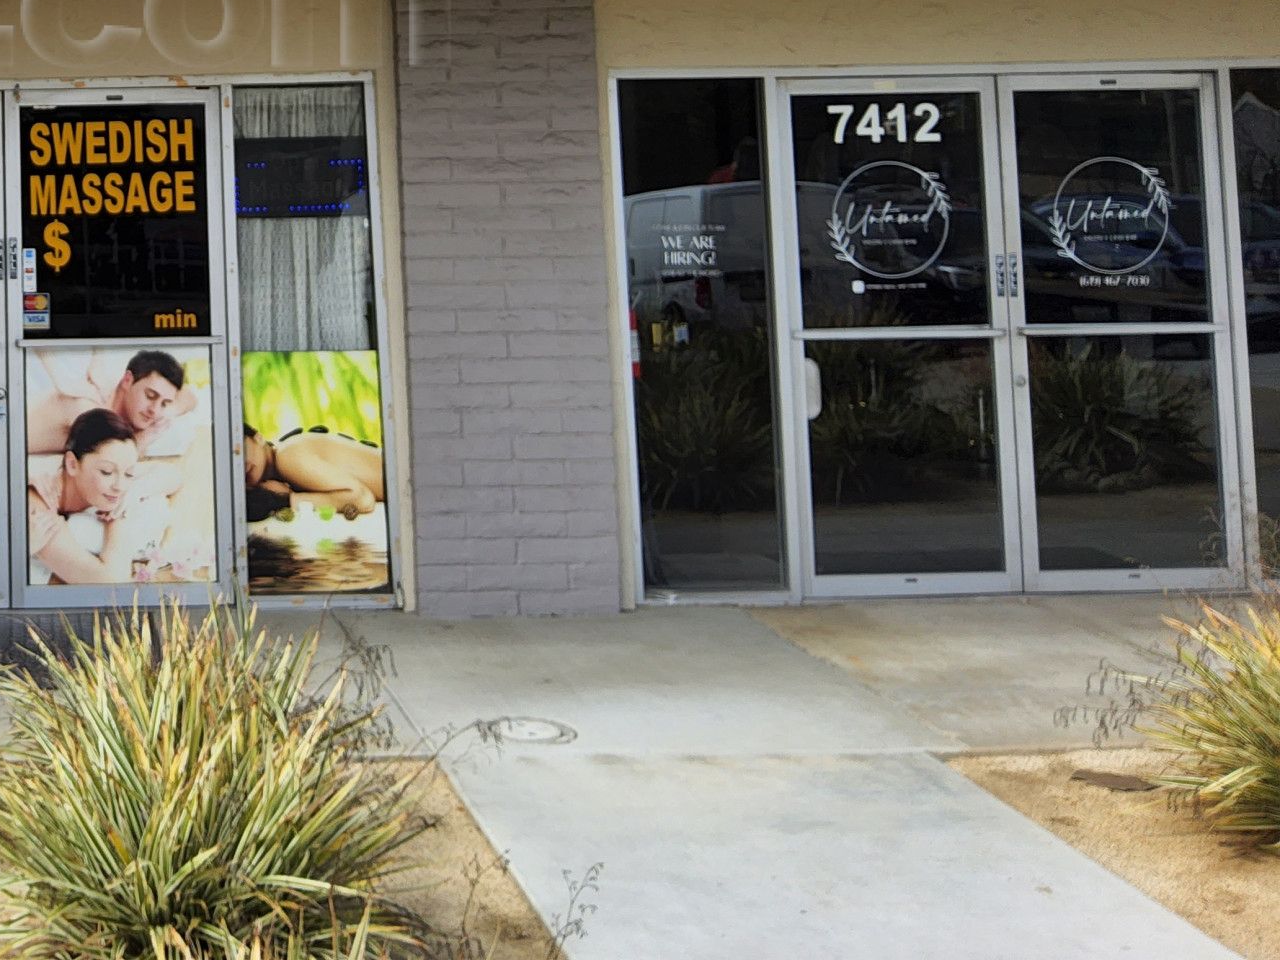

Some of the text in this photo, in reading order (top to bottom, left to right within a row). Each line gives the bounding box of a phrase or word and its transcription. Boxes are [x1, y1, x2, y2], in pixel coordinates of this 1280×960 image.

[29, 118, 195, 167] SWEDISH
[826, 102, 942, 144] 7412
[29, 171, 197, 217] MASSAGE
[42, 219, 72, 273] $
[661, 235, 717, 250] WE ARE
[153, 308, 197, 330] min
